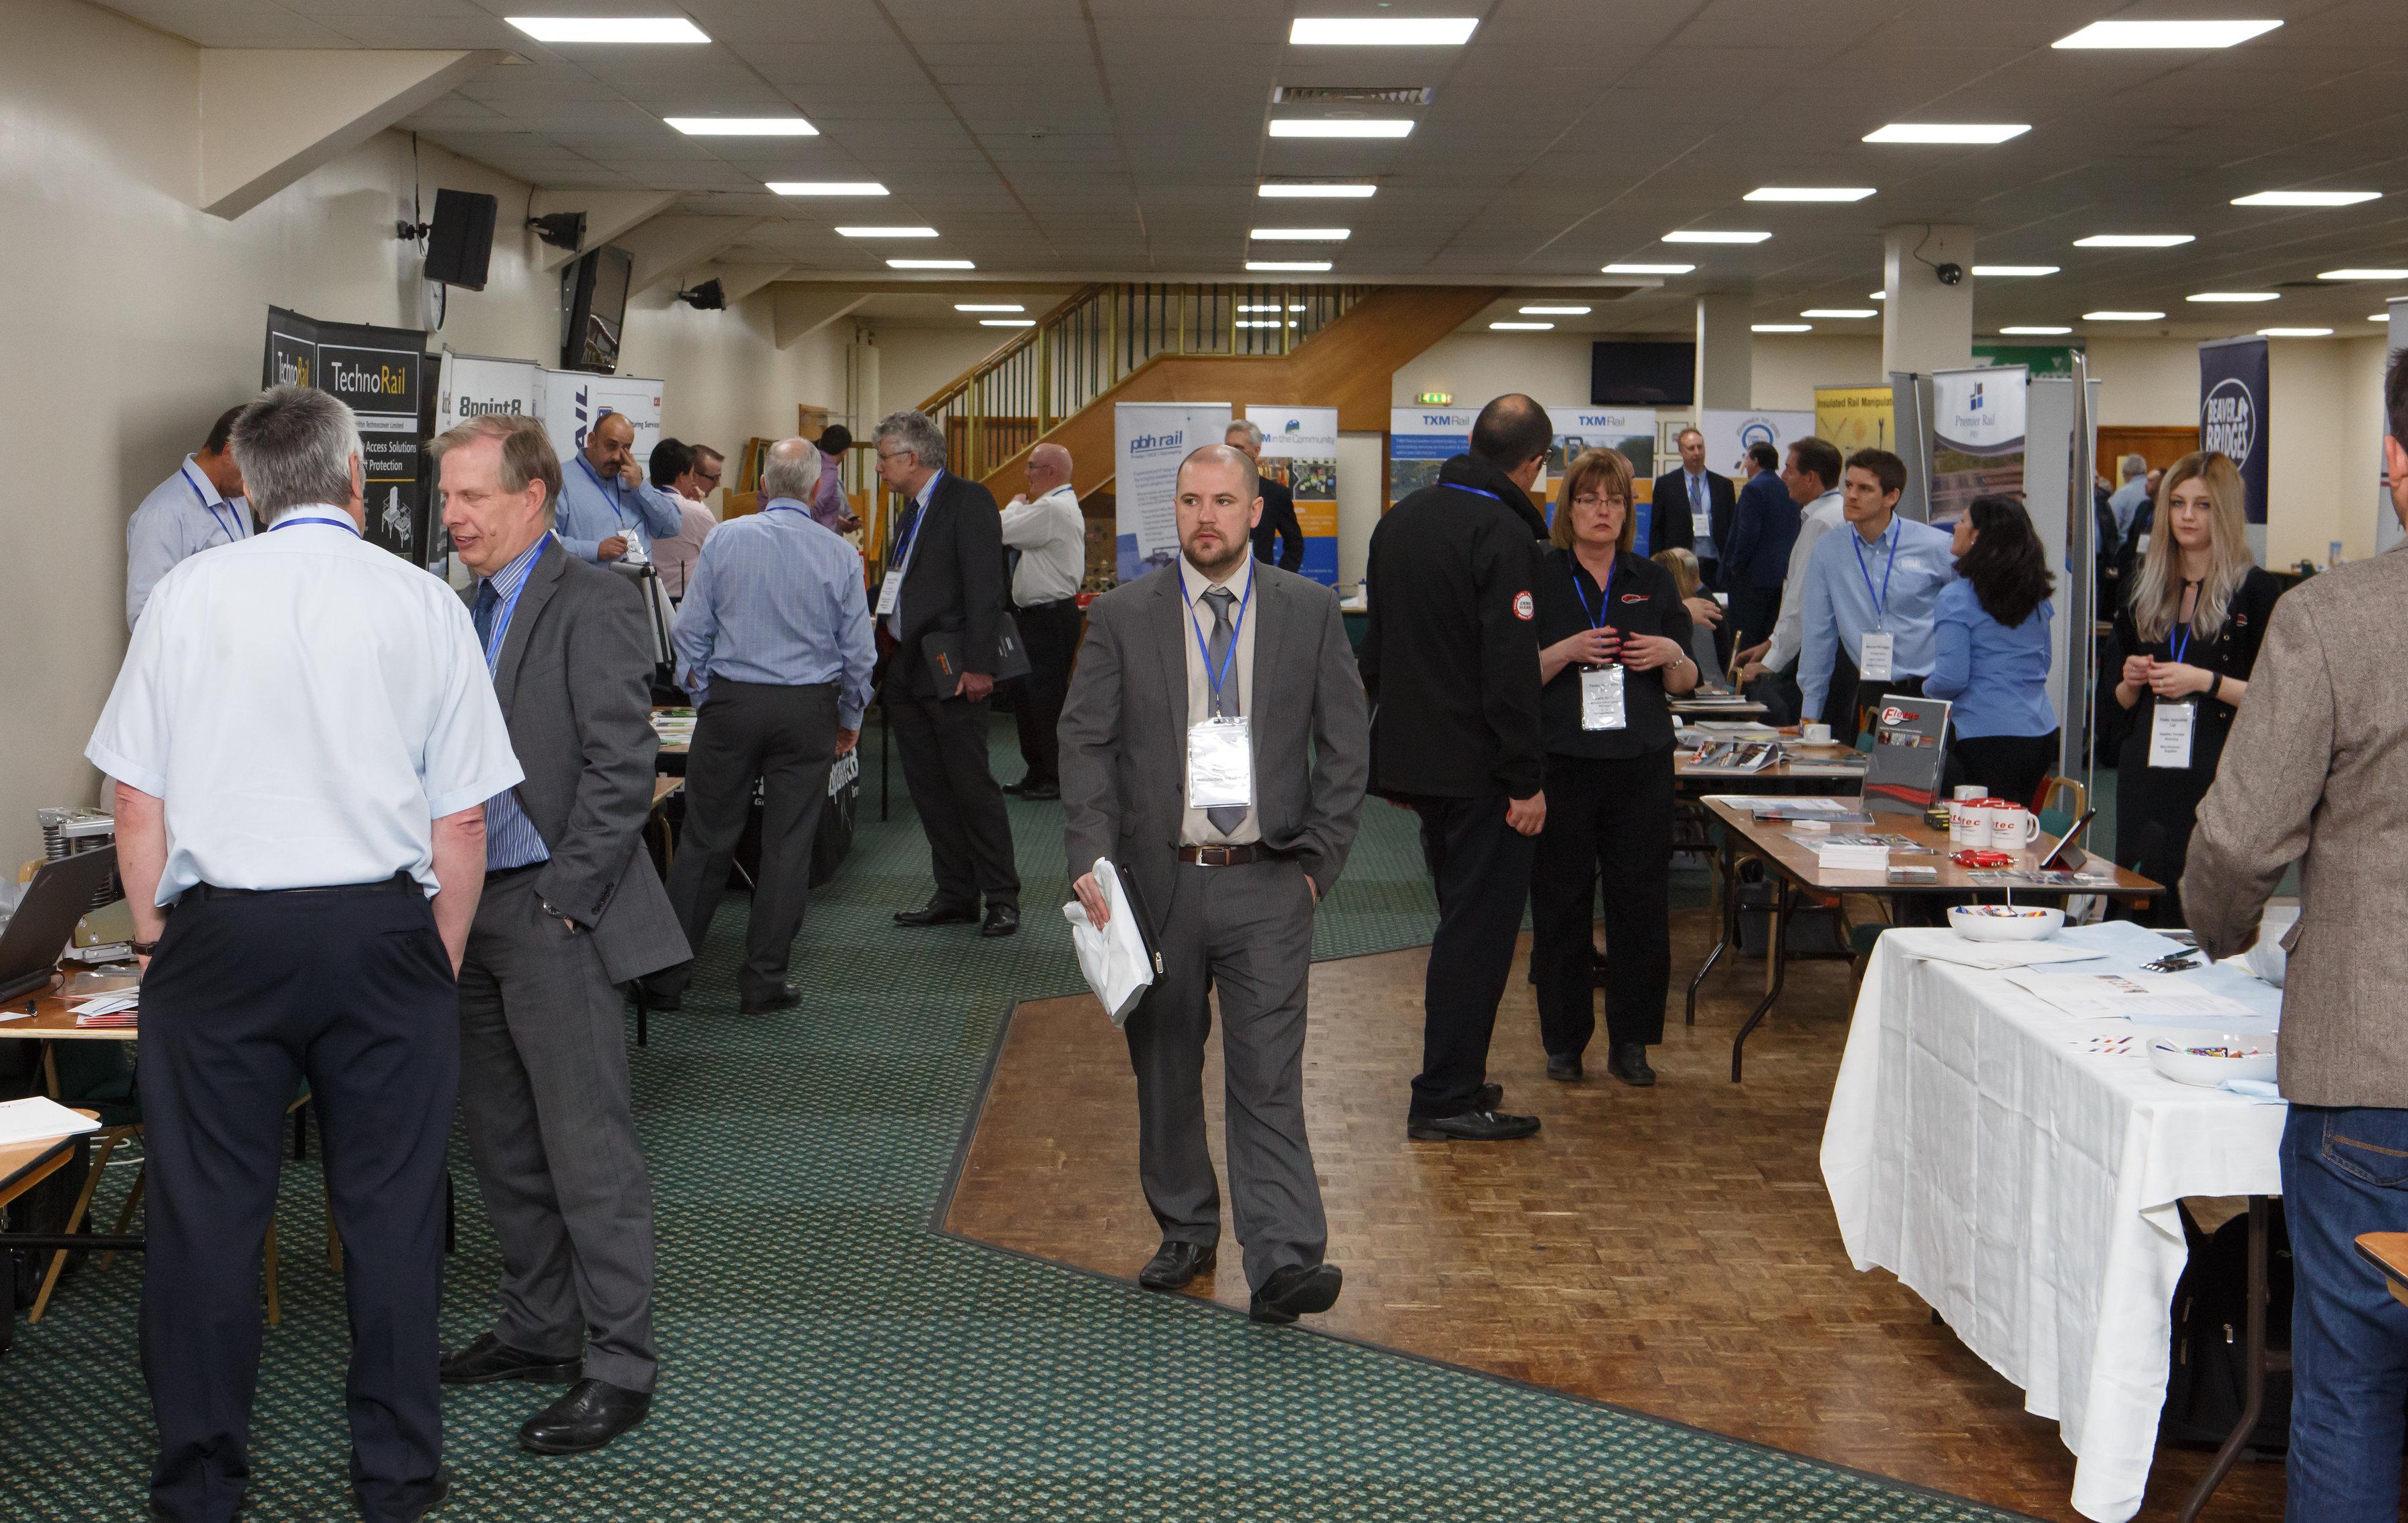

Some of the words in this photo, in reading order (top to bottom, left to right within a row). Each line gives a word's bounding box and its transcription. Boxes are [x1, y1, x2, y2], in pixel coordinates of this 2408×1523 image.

[278, 351, 310, 387] TechnoRail
[331, 362, 405, 395] TechnoRail
[1817, 399, 1846, 407] Insulated
[1847, 398, 1860, 407] Rail
[1861, 397, 1892, 408] Manipulat
[2208, 397, 2235, 423] BEAVER
[1423, 415, 1450, 425] TXM
[1451, 415, 1470, 426] Rail
[1579, 416, 1606, 426] TXM
[1607, 416, 1625, 426] Rail
[1955, 415, 1981, 426] Premier
[1982, 414, 1995, 425] Rail
[1130, 433, 1157, 453] pbh
[1159, 430, 1183, 446] rail
[2205, 419, 2248, 459] BRIDGES
[366, 440, 387, 453] Access
[389, 440, 417, 453] Solutions
[369, 459, 403, 471] Protection
